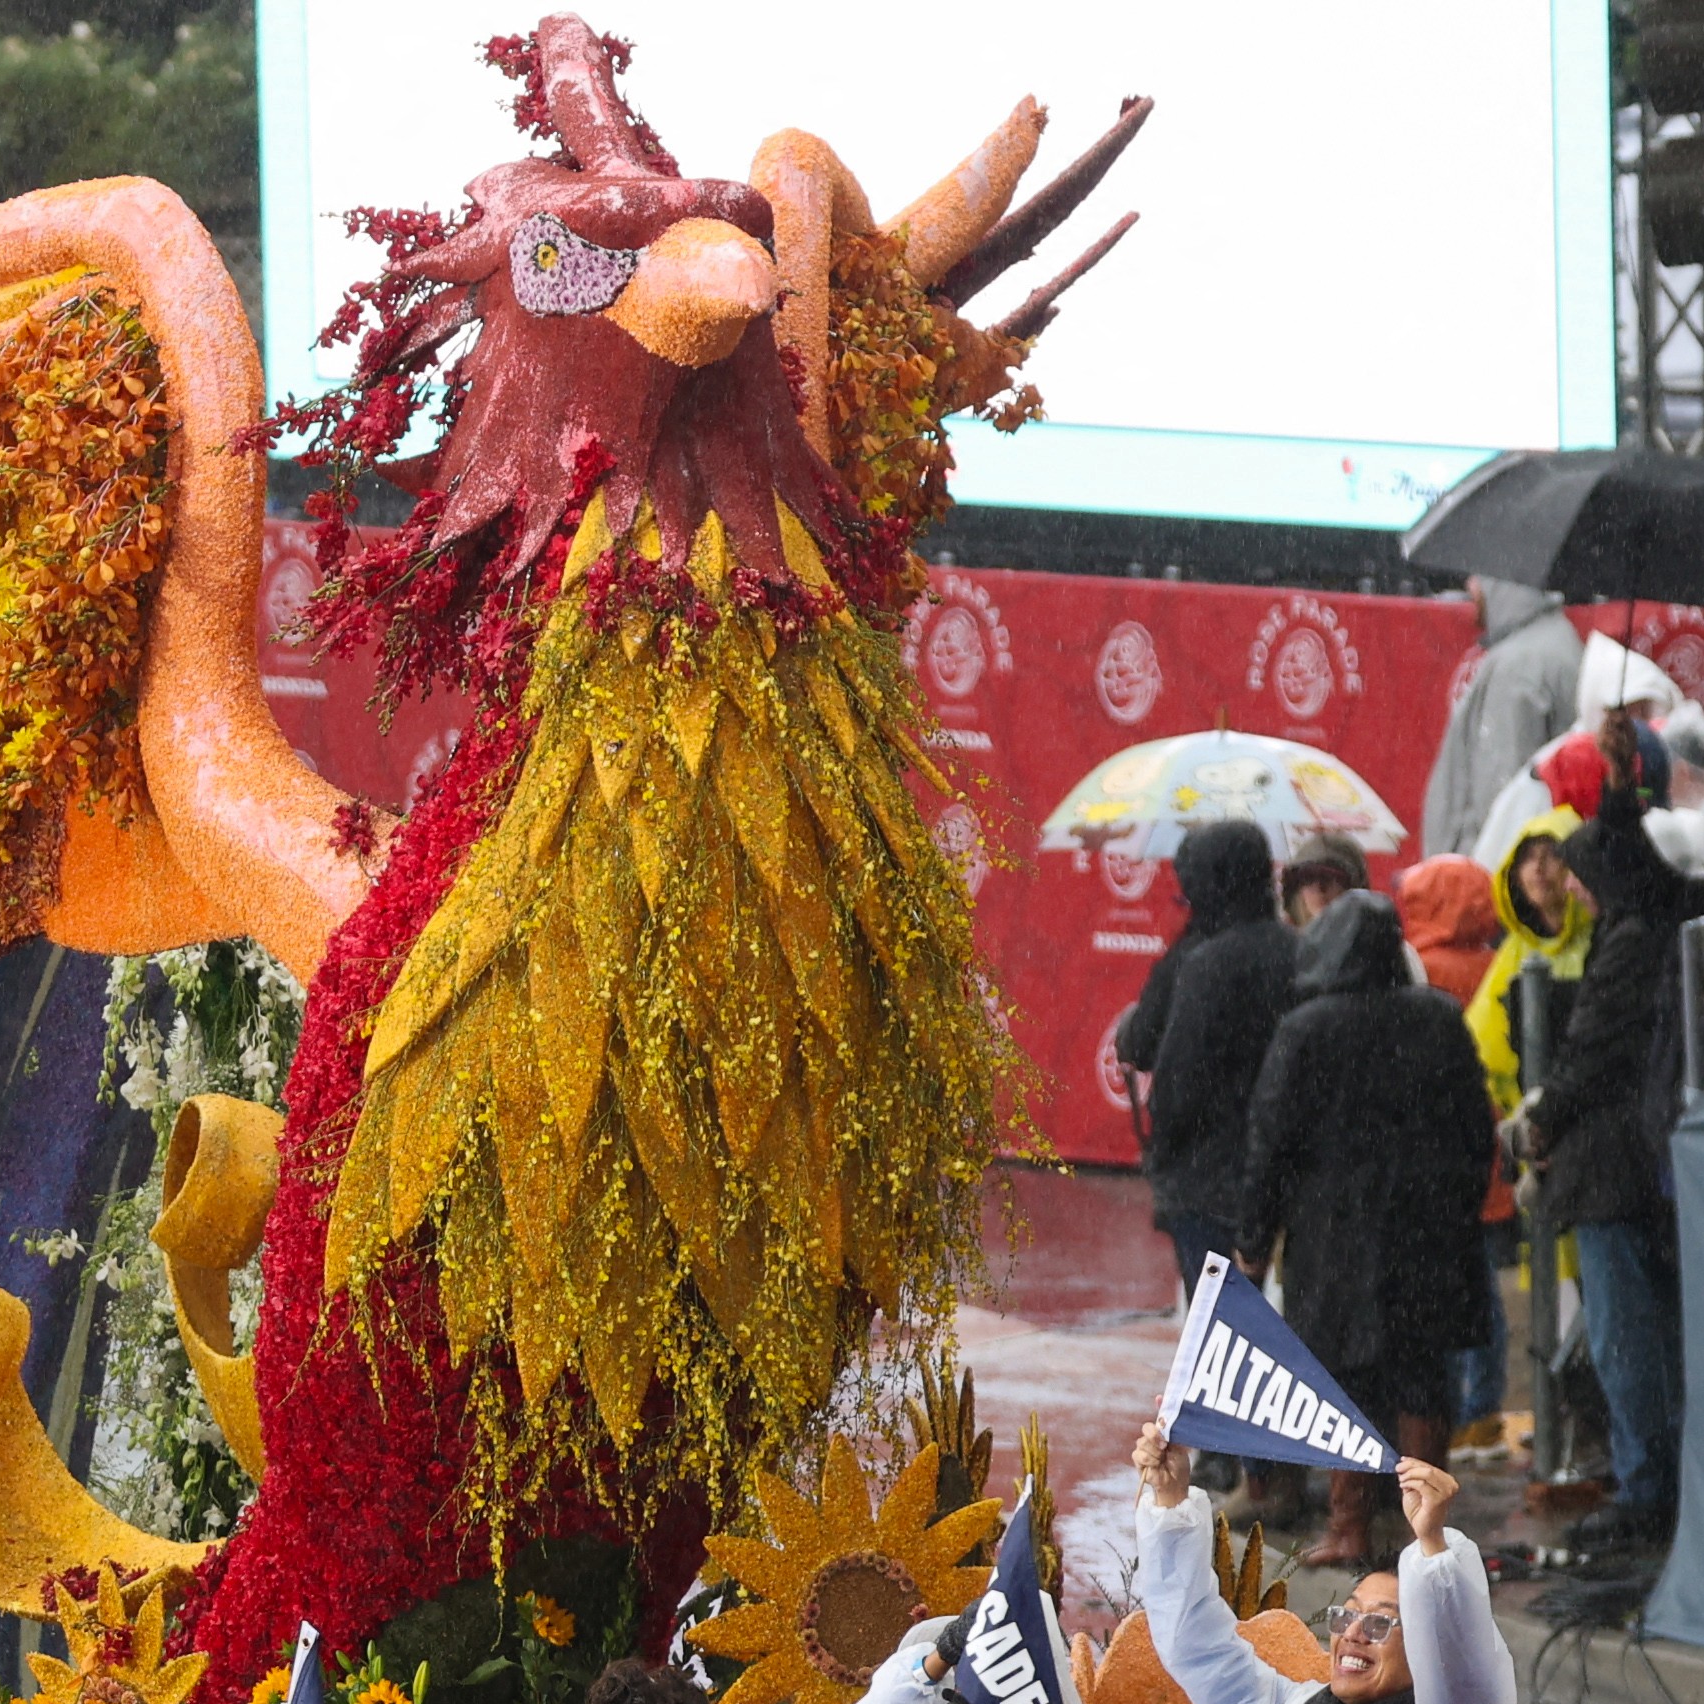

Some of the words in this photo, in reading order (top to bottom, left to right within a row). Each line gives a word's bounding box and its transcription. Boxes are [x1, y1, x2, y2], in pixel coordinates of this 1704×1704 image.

[1248, 604, 1289, 691] ROSE
[1290, 594, 1363, 693] PARADE
[1184, 1319, 1384, 1470] ALTADENA
